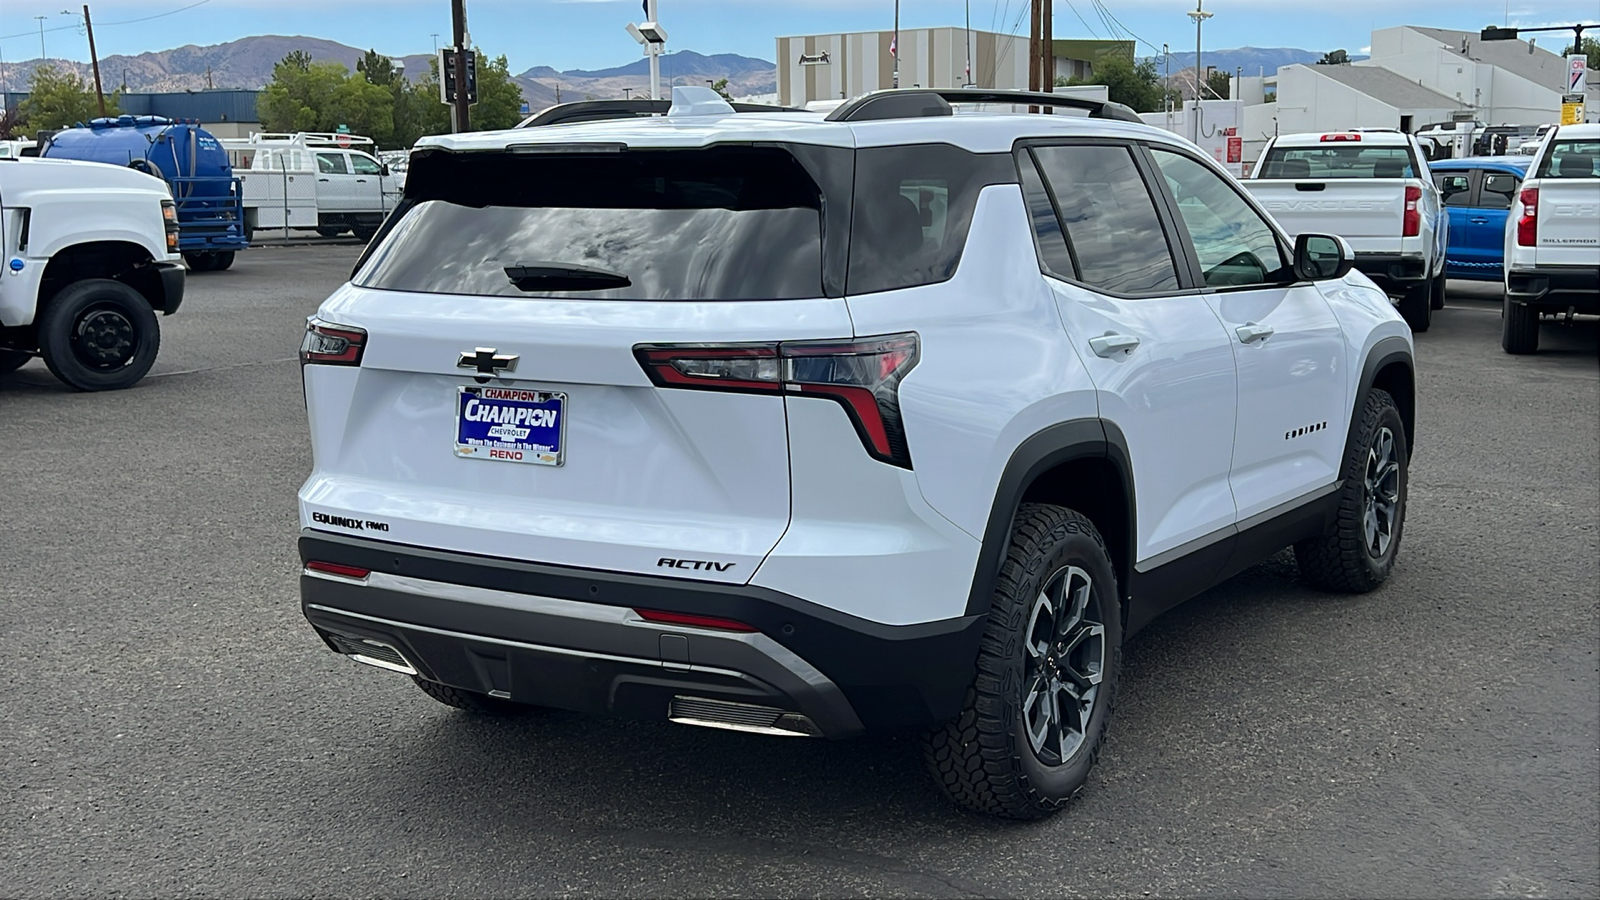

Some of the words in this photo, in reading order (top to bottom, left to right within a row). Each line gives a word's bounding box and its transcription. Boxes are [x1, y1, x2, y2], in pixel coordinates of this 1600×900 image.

[1259, 201, 1391, 211] EVROLET
[485, 389, 535, 401] CHAMPION
[491, 428, 527, 437] CHEVROLET
[1284, 421, 1327, 440] EQUINOX
[484, 439, 493, 447] The
[523, 442, 532, 450] The
[490, 450, 523, 460] RENO
[312, 512, 364, 530] EQUINOX
[365, 520, 389, 532] AWD
[657, 557, 736, 571] ACTIV
